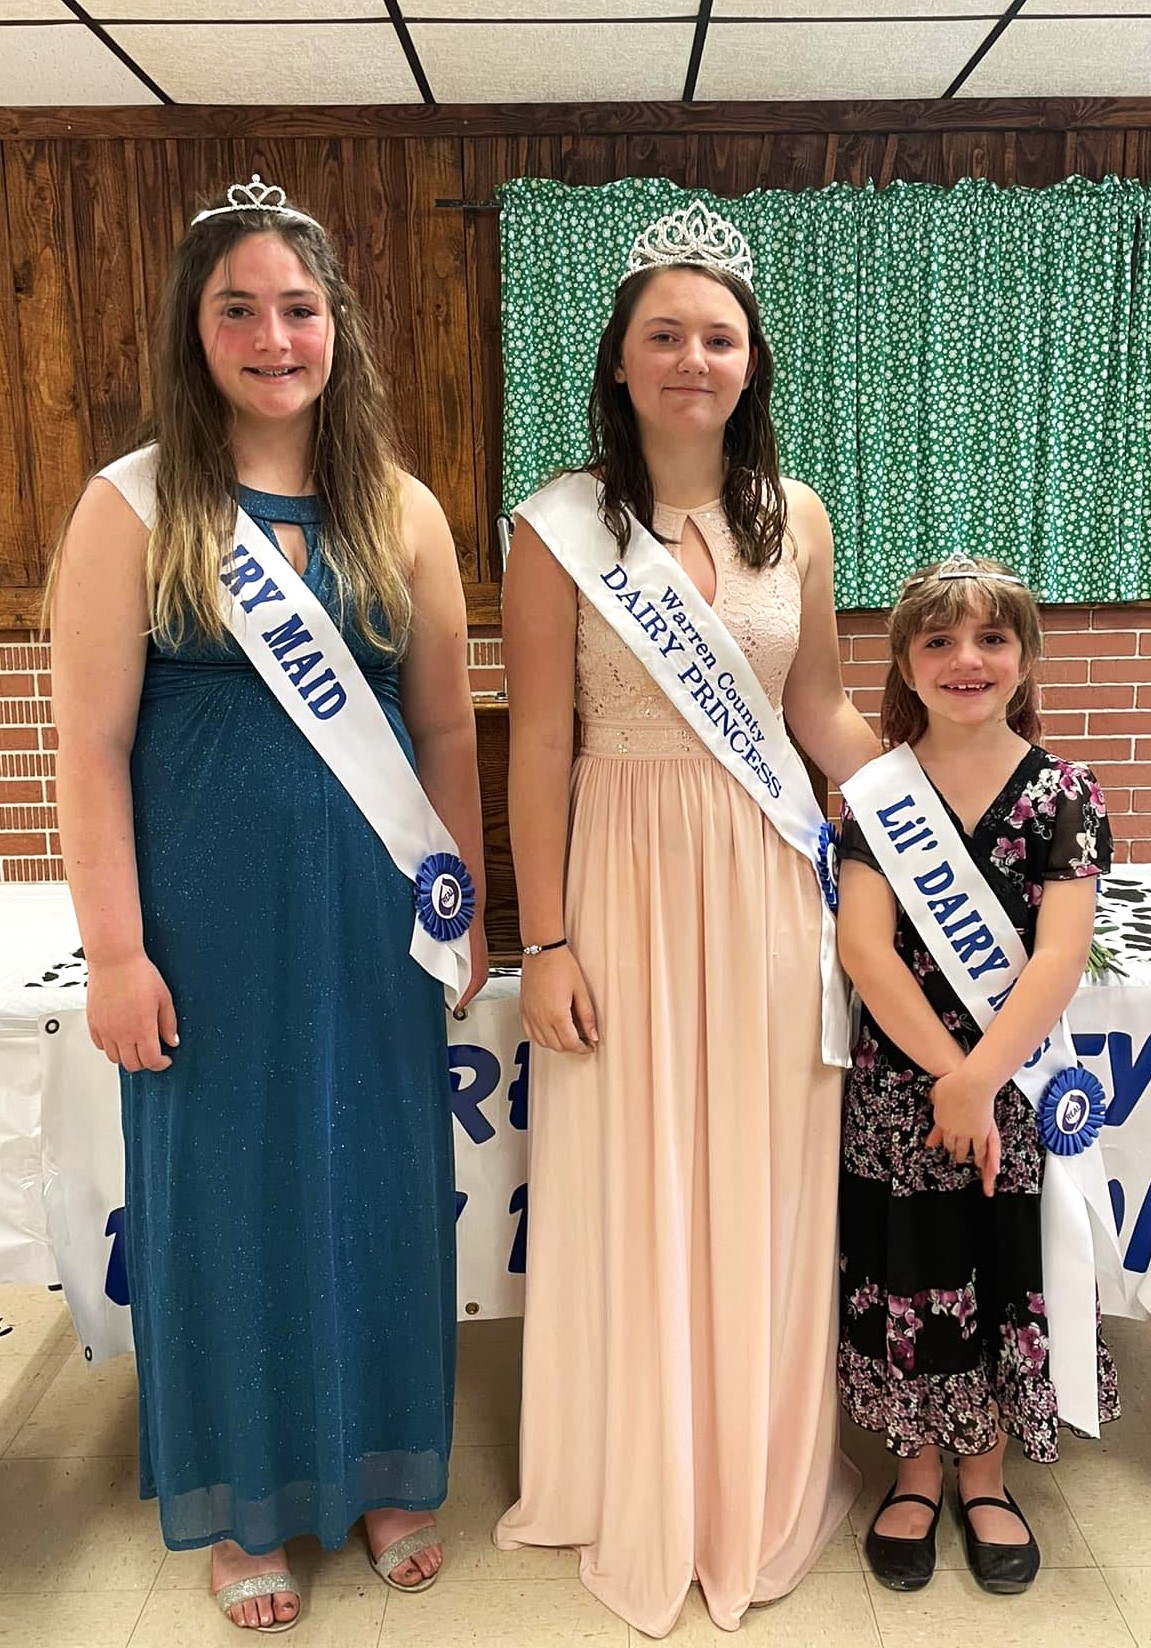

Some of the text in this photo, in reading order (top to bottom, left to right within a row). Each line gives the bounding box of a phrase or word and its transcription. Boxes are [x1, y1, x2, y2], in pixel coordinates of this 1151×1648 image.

[221, 544, 347, 719] IRY MAID
[600, 564, 783, 799] DAIRY PRINCESS
[661, 586, 766, 743] Warren County
[914, 861, 1010, 980] DAIRY
